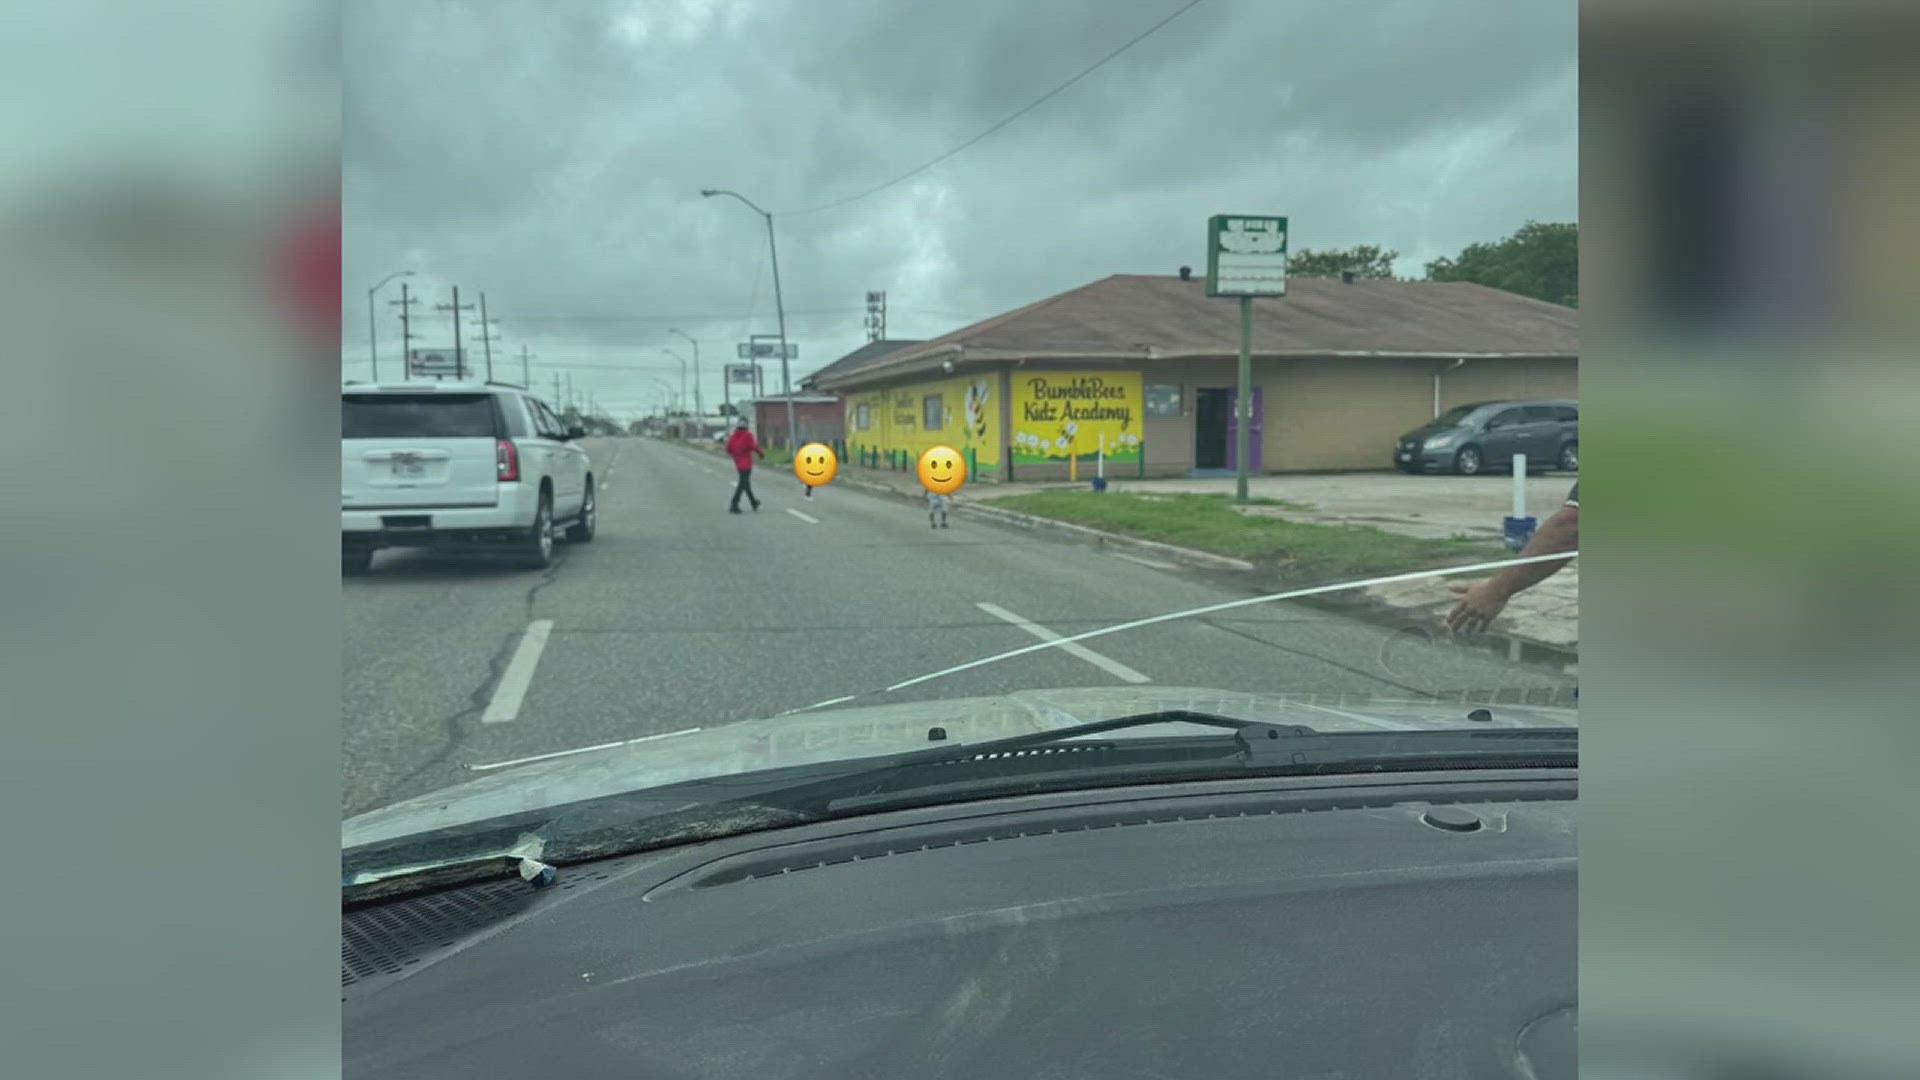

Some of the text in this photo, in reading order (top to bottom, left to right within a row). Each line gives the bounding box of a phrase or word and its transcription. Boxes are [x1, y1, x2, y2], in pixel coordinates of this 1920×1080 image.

[1027, 377, 1126, 400] BumbleBees
[1024, 401, 1133, 431] Kidz Academy
